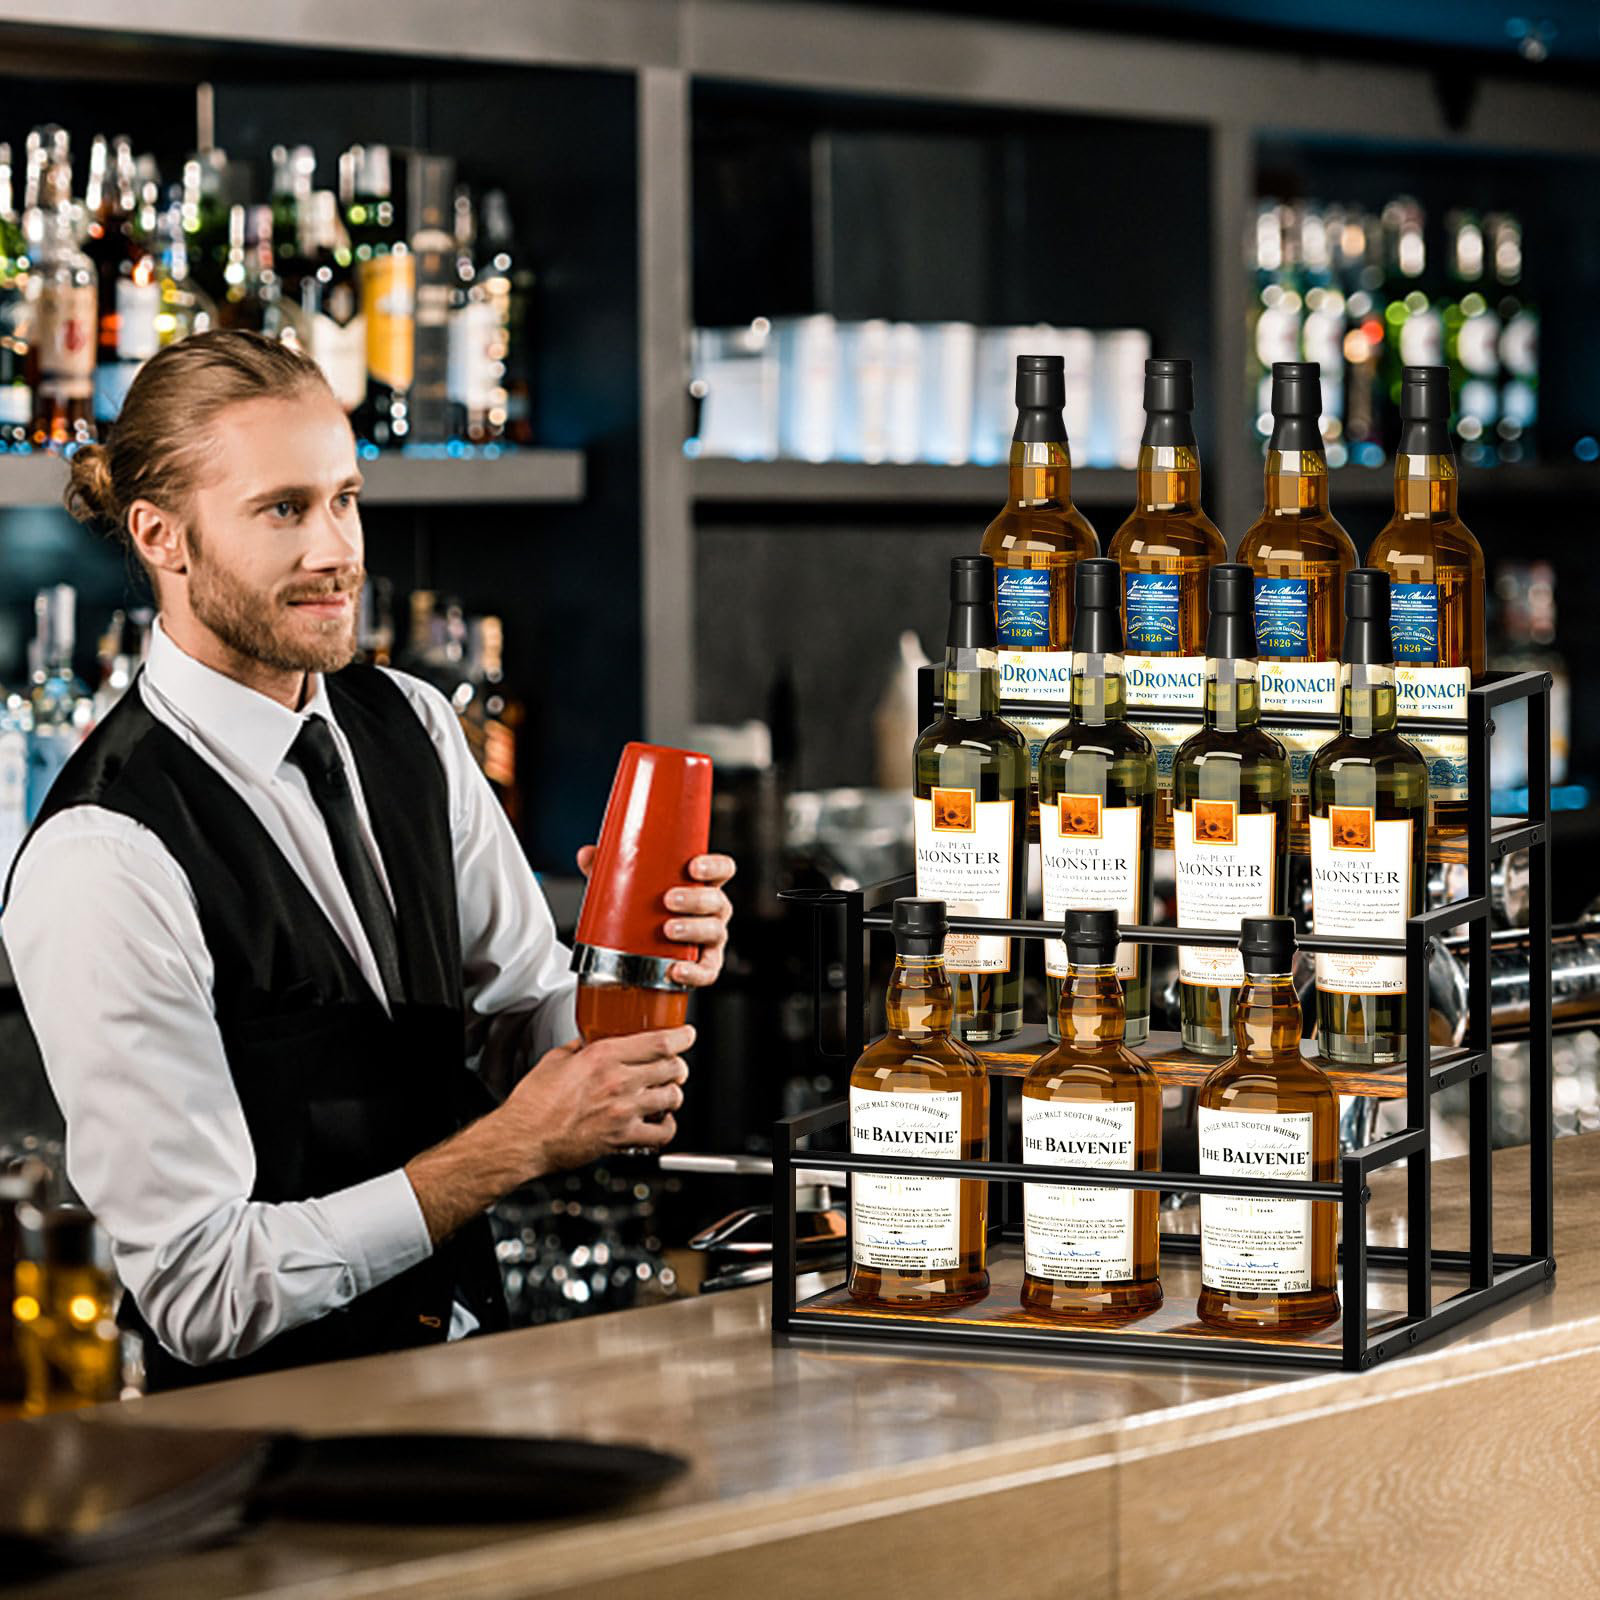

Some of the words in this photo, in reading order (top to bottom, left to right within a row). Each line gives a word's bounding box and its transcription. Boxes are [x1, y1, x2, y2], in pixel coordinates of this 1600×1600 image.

[1011, 628, 1033, 637] 1826
[1141, 634, 1162, 642] 1826
[1269, 639, 1291, 648] 1826
[1399, 644, 1421, 653] 1826
[919, 848, 1000, 864] MONSTER
[1075, 848, 1099, 856] PEAT
[1210, 854, 1233, 862] PEAT
[1045, 854, 1128, 871] MONSTER
[1179, 861, 1263, 877] MONSTER
[1347, 861, 1371, 870] PEAT
[1316, 867, 1400, 884] MONSTER
[871, 1100, 888, 1108] MALT
[890, 1100, 919, 1111] SCOTCH
[921, 1105, 950, 1120] WHISKY
[1064, 1111, 1093, 1121] SCOTCH
[1095, 1115, 1122, 1130] WHISKY
[852, 1126, 870, 1140] THE
[873, 1126, 954, 1144] BALVENIE
[1221, 1121, 1239, 1129] MALT
[1241, 1121, 1271, 1132] SCOTCH
[1273, 1126, 1301, 1141] WHISKY
[1025, 1136, 1042, 1150] THE
[1045, 1136, 1127, 1154] BALVENIE
[1202, 1147, 1220, 1161] THE
[1223, 1147, 1306, 1165] BALVENIE
